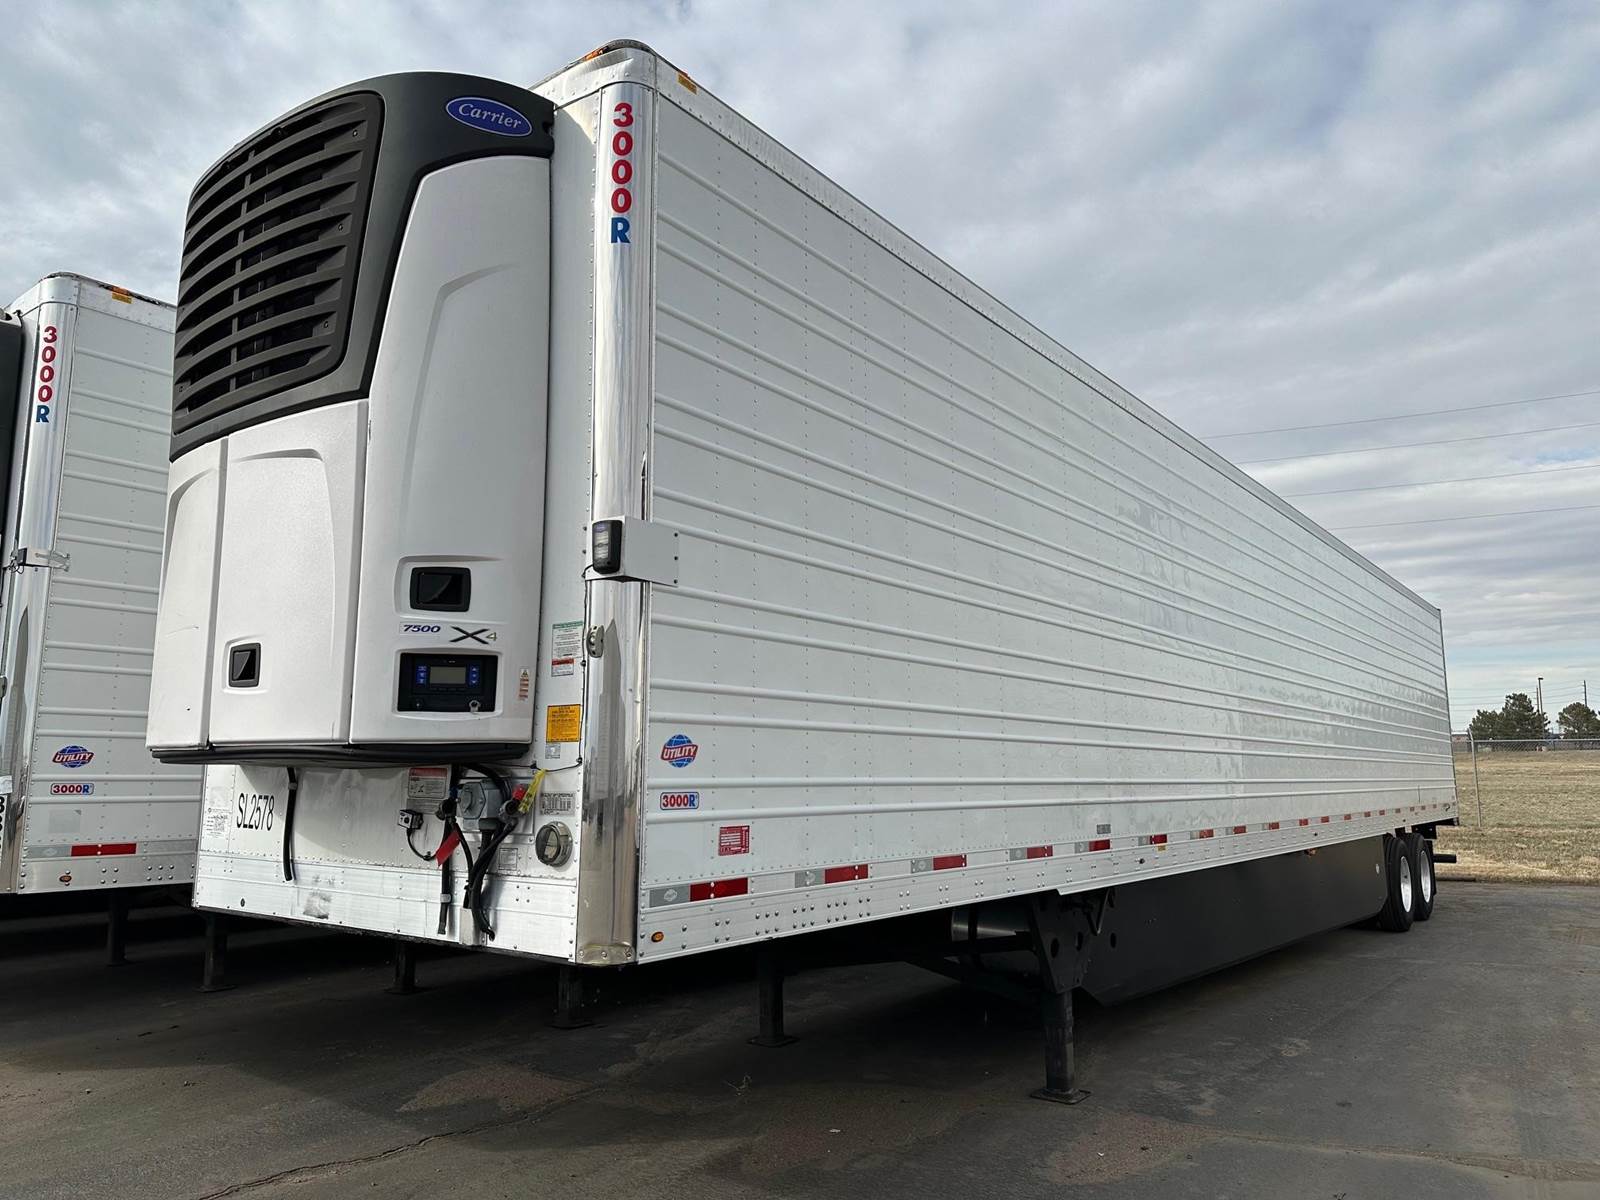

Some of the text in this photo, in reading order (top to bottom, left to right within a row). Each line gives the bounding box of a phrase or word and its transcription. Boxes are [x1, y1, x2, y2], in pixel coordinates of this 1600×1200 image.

[458, 103, 522, 129] Carrier
[610, 102, 634, 244] 3000R
[35, 325, 58, 423] 3000R
[403, 624, 441, 633] 7500
[55, 753, 93, 763] UTILITY
[663, 745, 697, 759] UTILITY
[53, 784, 91, 794] 3000R
[662, 793, 696, 808] 3000R
[236, 792, 275, 832] SL2578
